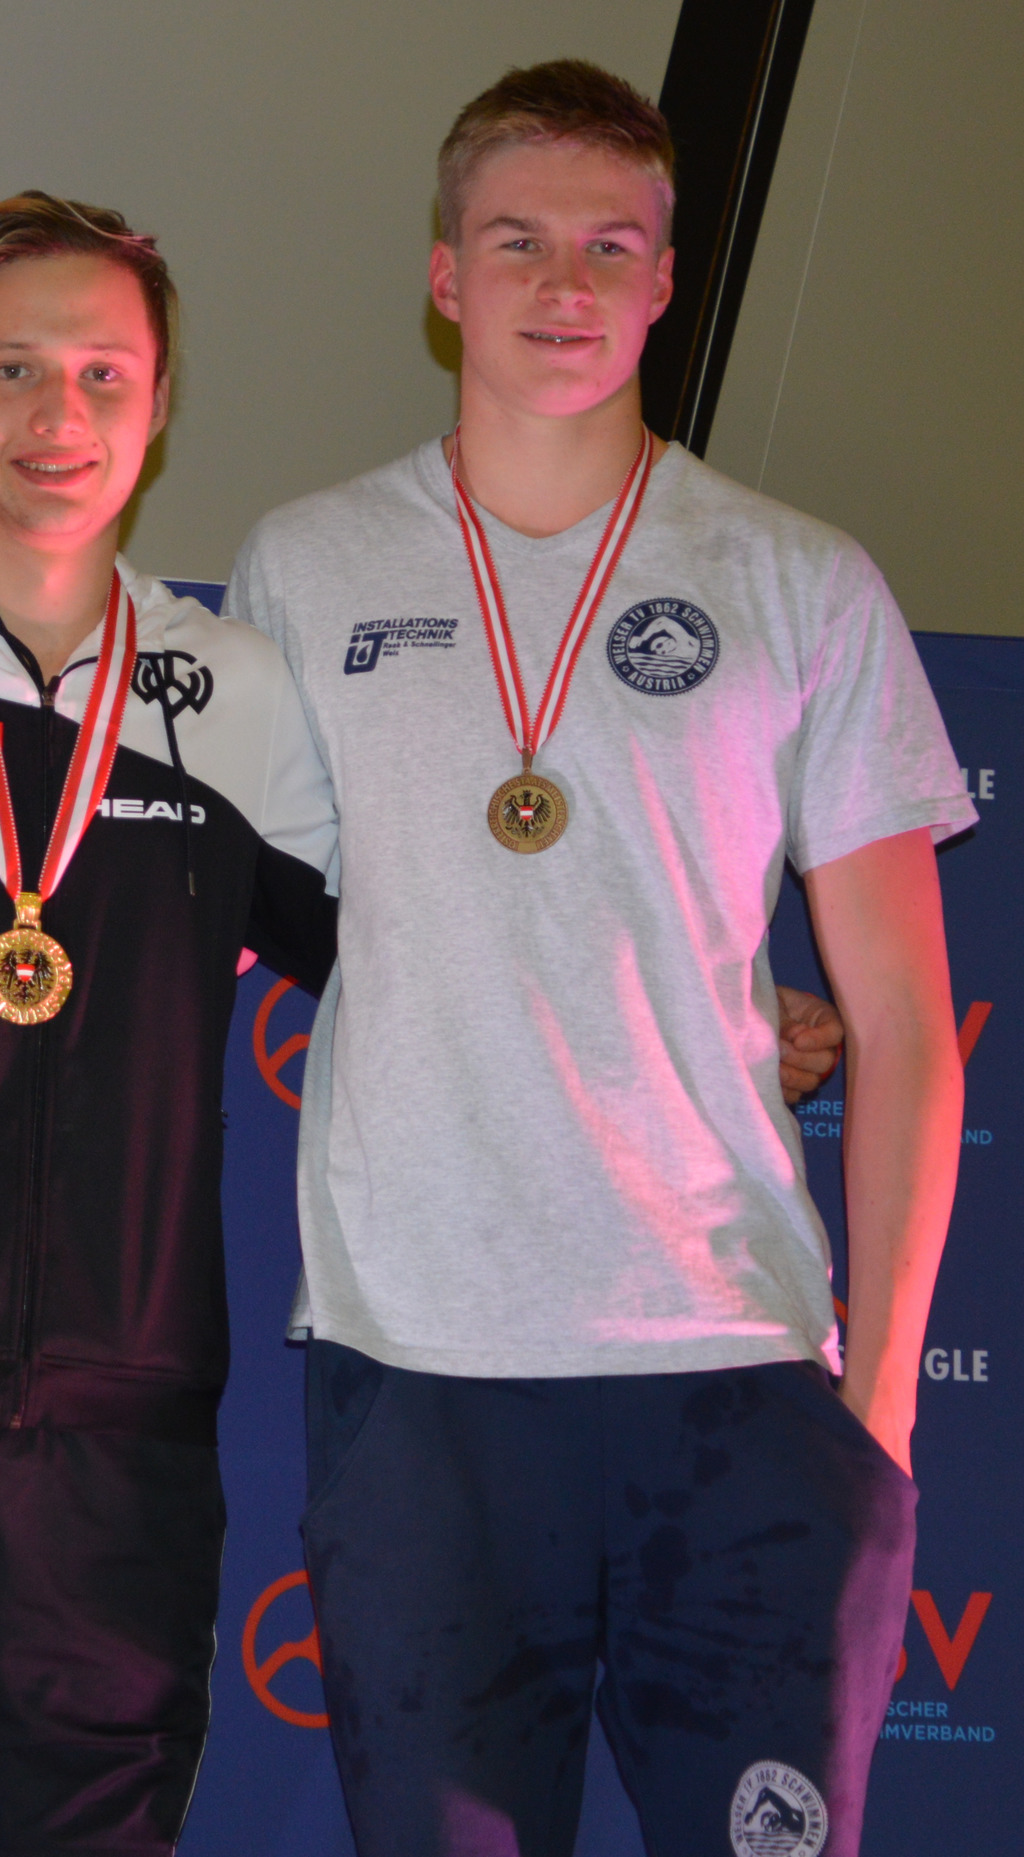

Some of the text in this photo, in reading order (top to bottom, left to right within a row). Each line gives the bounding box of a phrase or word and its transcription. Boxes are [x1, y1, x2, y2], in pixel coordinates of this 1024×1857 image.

[352, 618, 459, 633] INSTALLATIONS
[388, 629, 455, 640] TECHNIK
[612, 603, 715, 674] WELSER TV 1862 SCHWIMMEN
[627, 671, 686, 691] AUSTRIA
[802, 1121, 843, 1138] SCH
[923, 1347, 990, 1383] GLE
[886, 1700, 949, 1719] SCHER
[879, 1723, 996, 1743] MVERBAND
[780, 1772, 822, 1849] SCHWIMMEN
